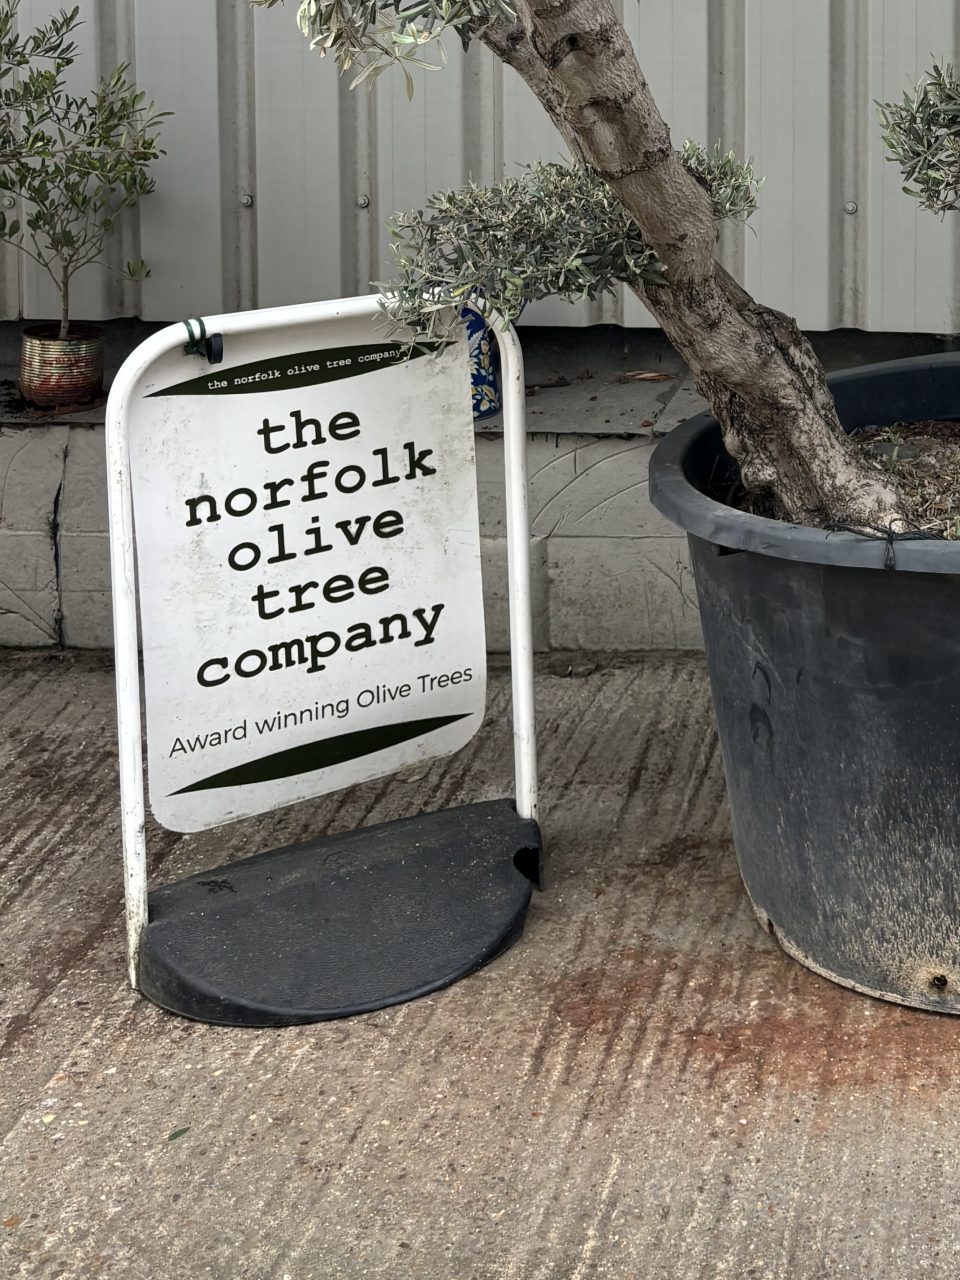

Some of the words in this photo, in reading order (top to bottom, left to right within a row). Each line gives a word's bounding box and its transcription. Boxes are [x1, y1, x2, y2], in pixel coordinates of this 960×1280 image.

[207, 379, 228, 390] the
[233, 369, 282, 386] norfolk
[287, 362, 320, 376] olive
[326, 356, 352, 369] tree
[357, 349, 401, 363] company
[257, 410, 360, 455] the
[185, 442, 436, 526] norfolk
[228, 508, 404, 572] olive
[251, 566, 390, 620] tree
[196, 603, 445, 688] company
[169, 719, 247, 758] Award
[254, 698, 349, 735] winning
[356, 683, 412, 709] Olive
[417, 666, 474, 694] Trees
